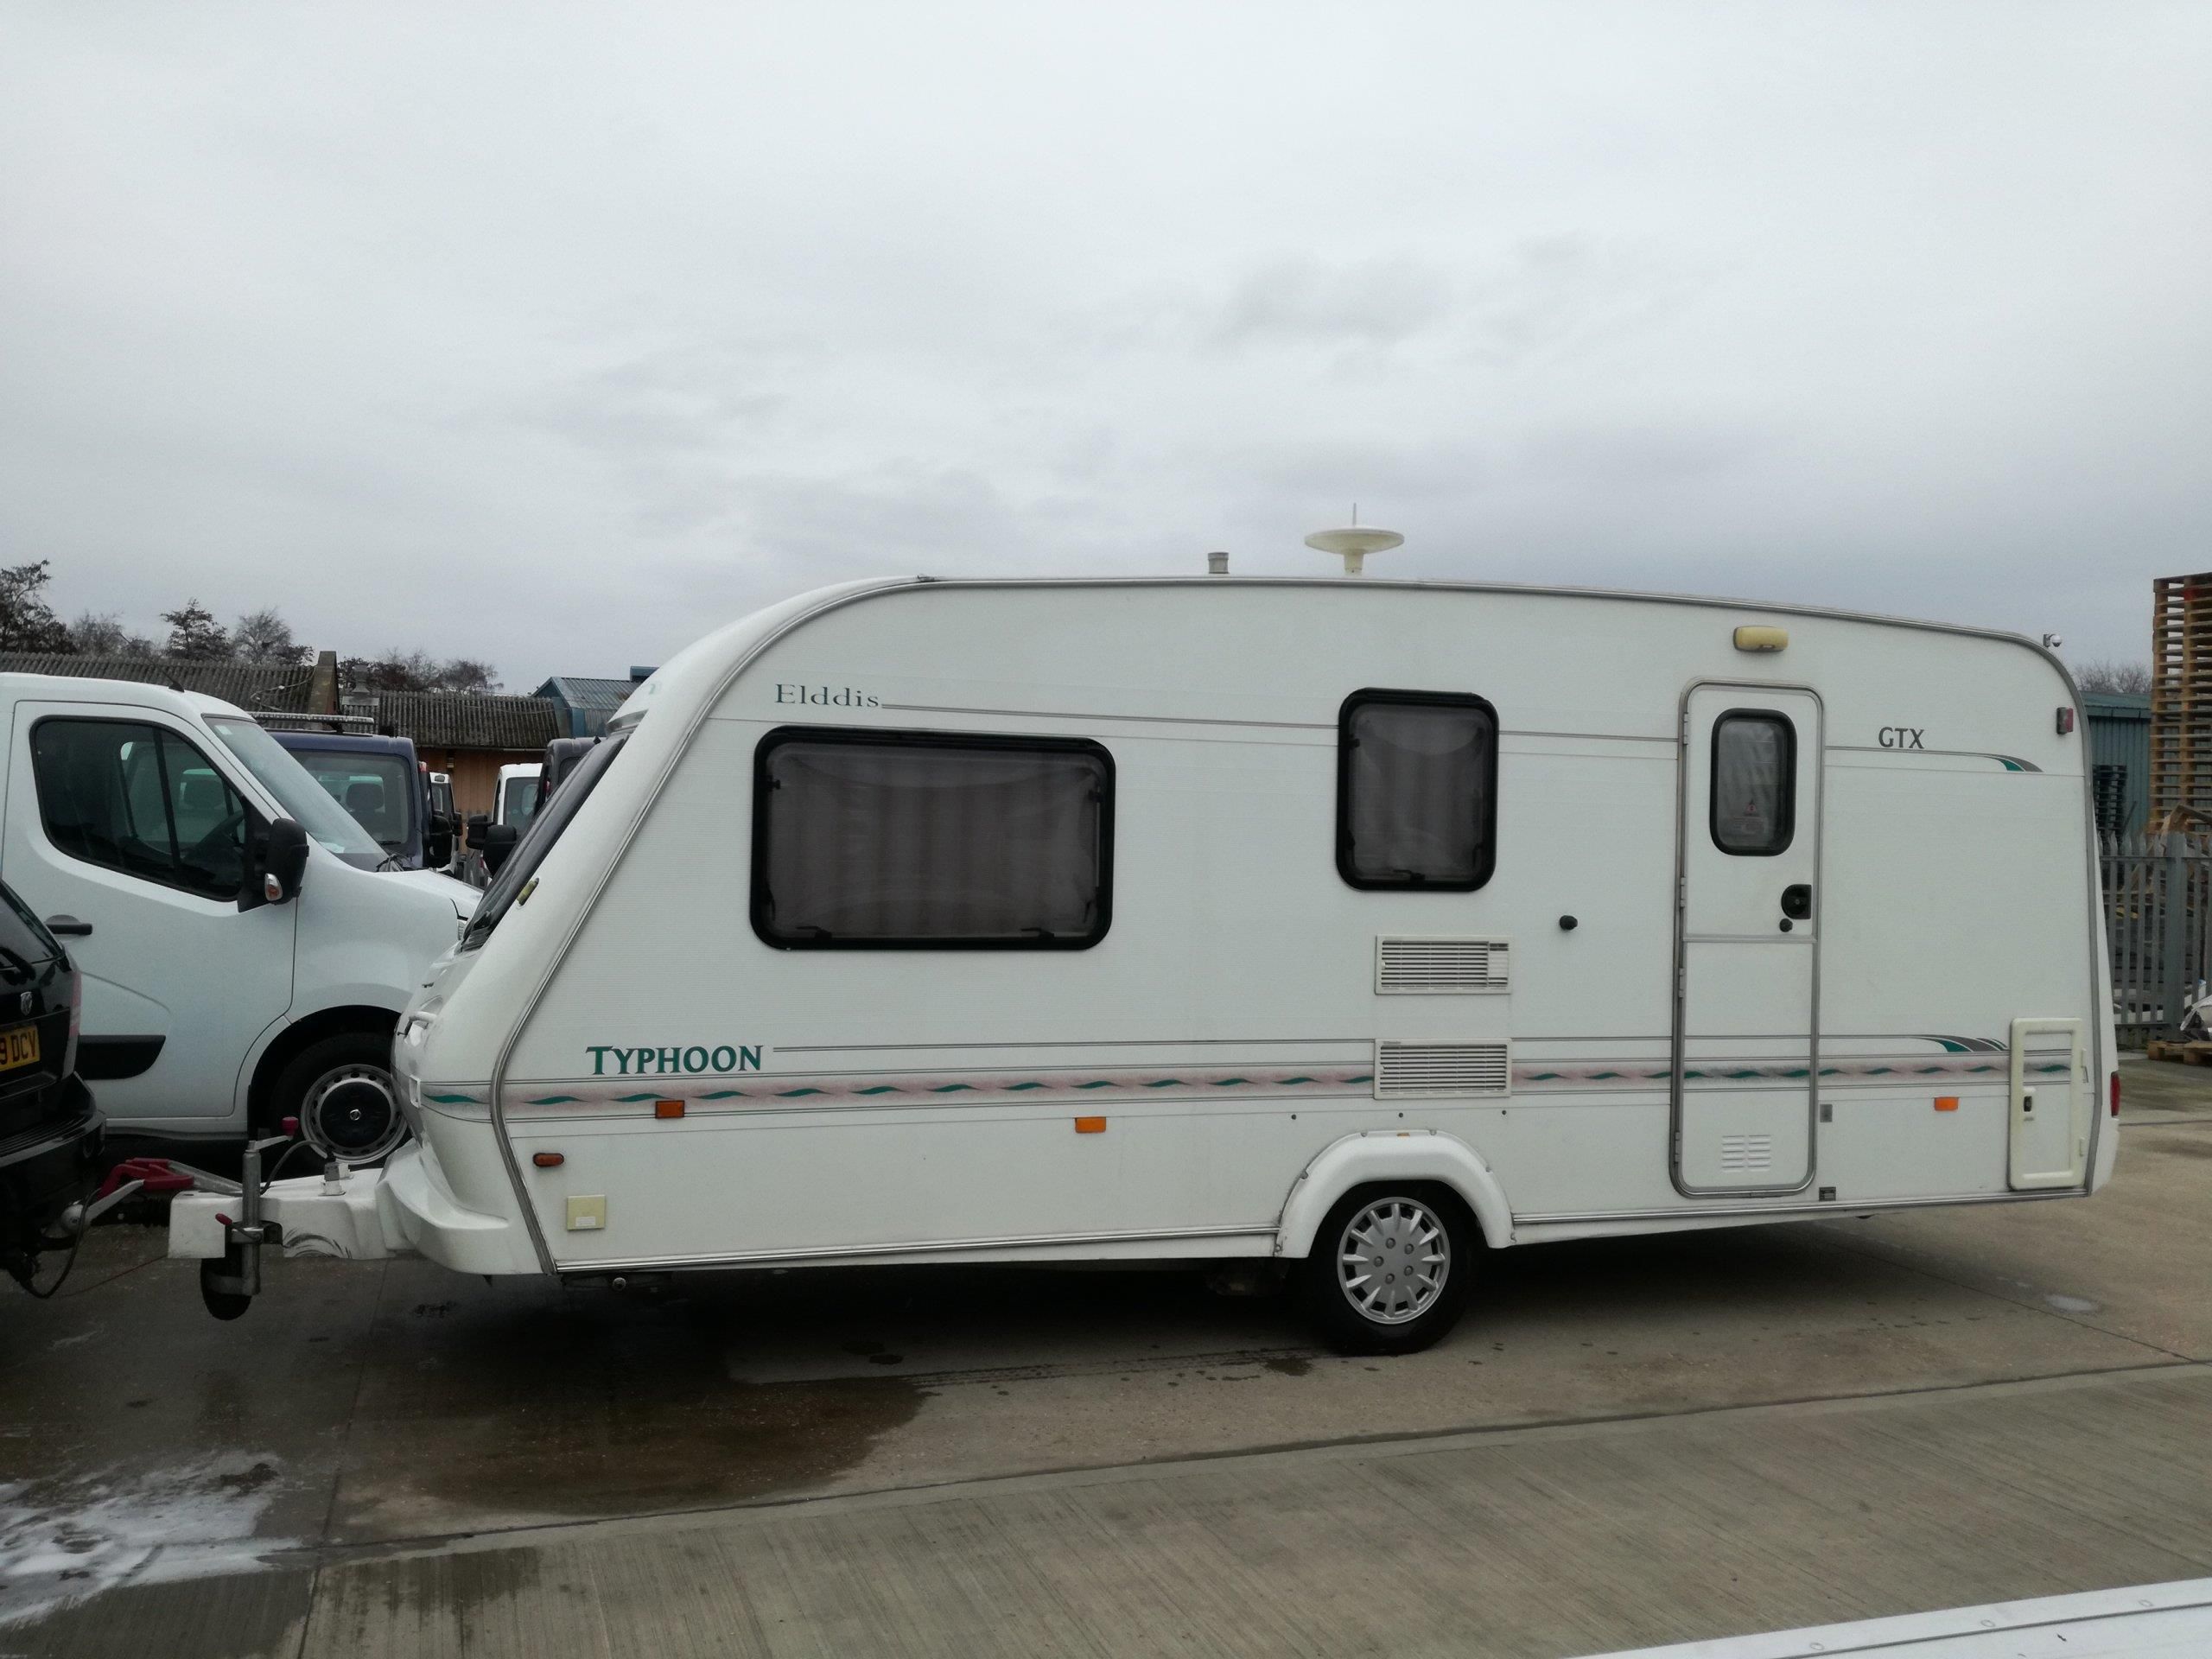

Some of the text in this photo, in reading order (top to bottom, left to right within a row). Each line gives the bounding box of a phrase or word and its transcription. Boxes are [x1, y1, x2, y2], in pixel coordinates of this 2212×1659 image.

[774, 683, 879, 708] Elddis
[1878, 726, 1925, 749] GTX
[585, 1045, 764, 1075] TYPHOON
